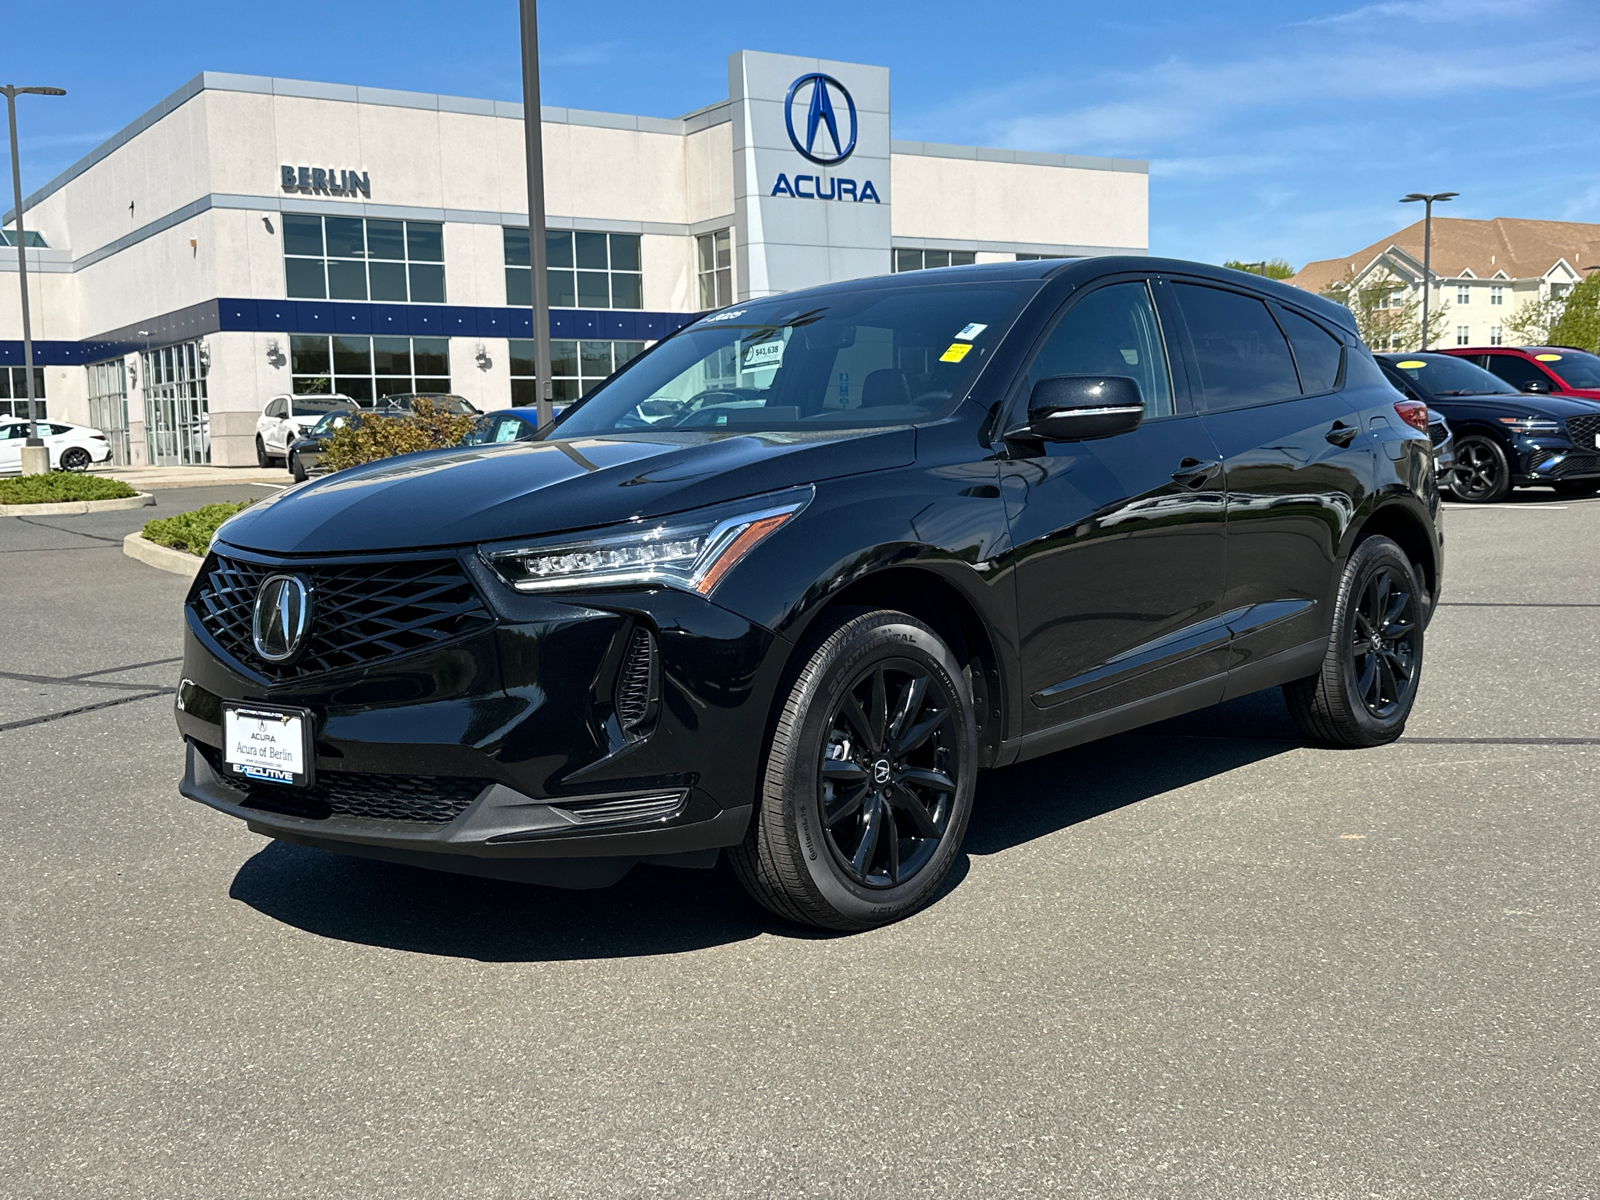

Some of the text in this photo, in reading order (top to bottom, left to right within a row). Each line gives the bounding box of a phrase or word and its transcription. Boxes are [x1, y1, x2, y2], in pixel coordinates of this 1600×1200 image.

[281, 165, 370, 195] BERLIN
[770, 173, 881, 204] ACURA
[755, 345, 779, 357] $41,638
[250, 732, 276, 743] ACURA
[236, 741, 293, 762] Acura of Berlin
[233, 763, 293, 781] EXECUTIVE
